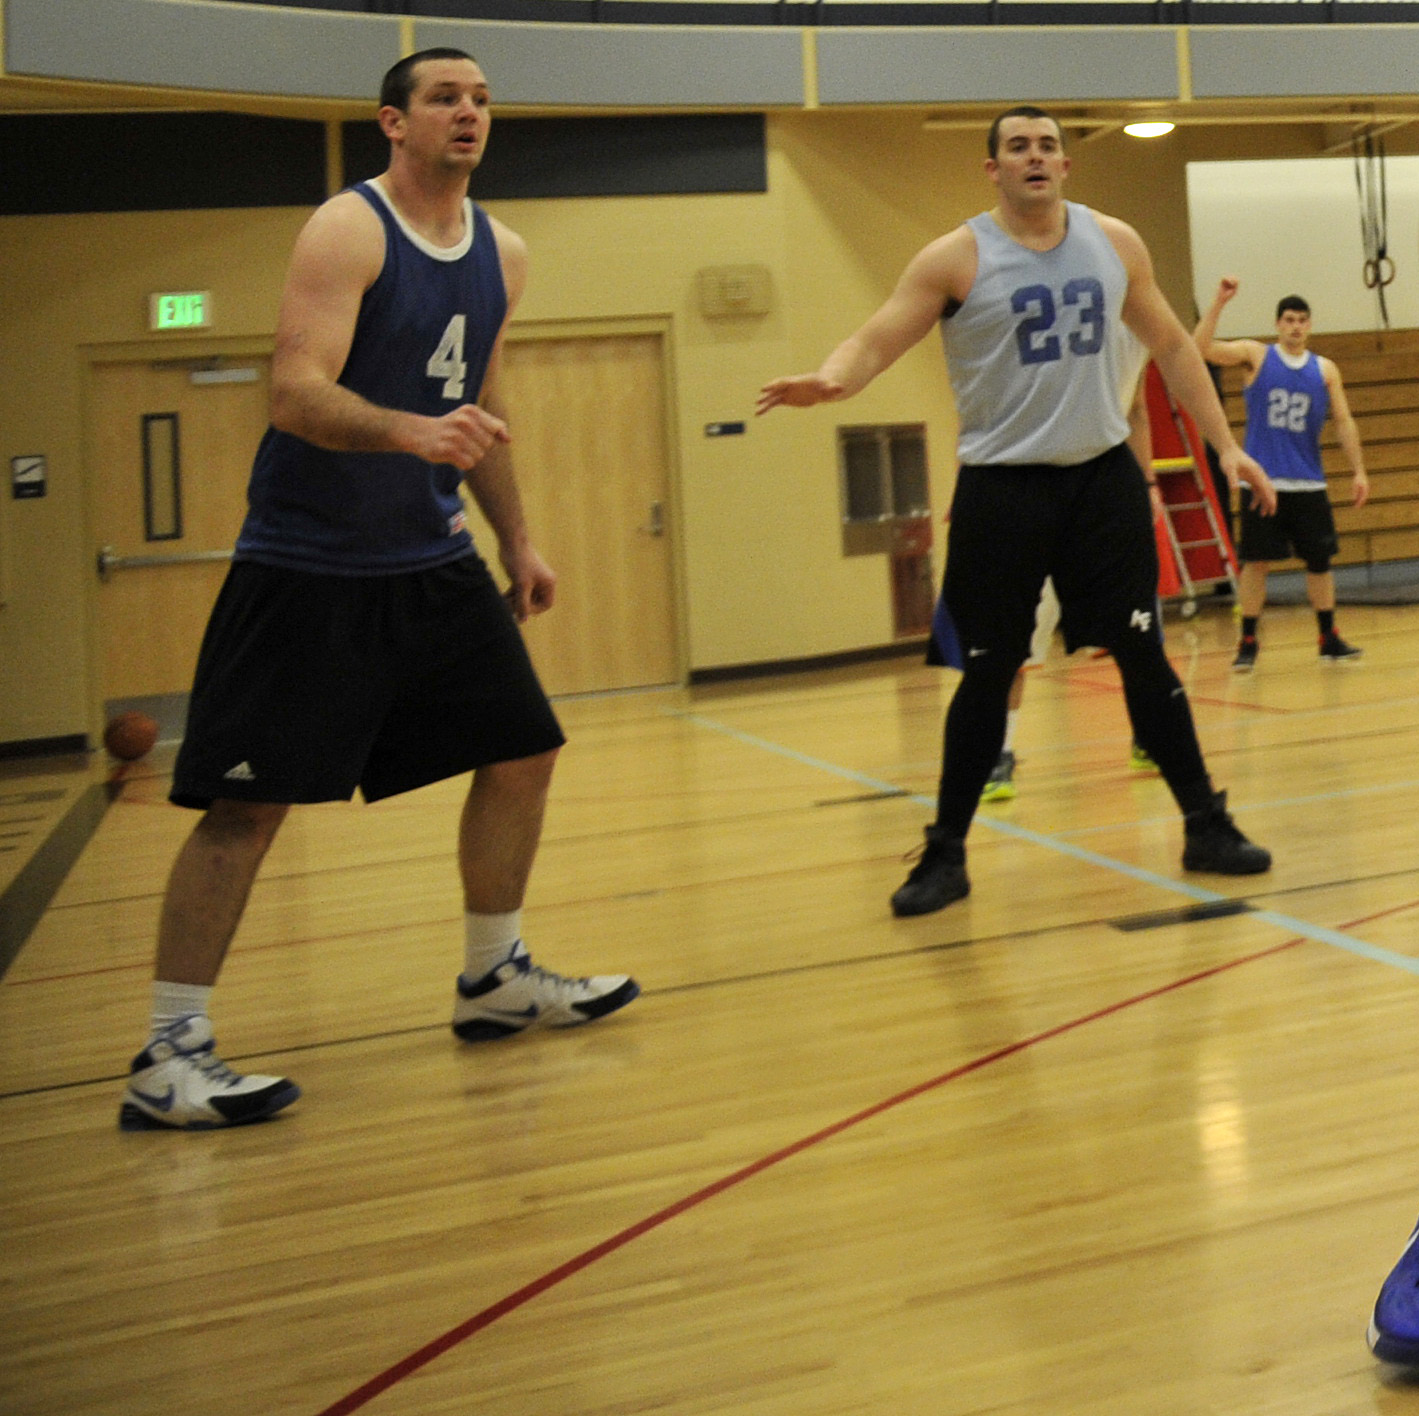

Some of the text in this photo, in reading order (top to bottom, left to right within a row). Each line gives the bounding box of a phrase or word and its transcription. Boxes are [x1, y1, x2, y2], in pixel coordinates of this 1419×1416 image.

[426, 313, 468, 400] 4
[1010, 276, 1106, 367] 23
[1266, 387, 1312, 434] 22
